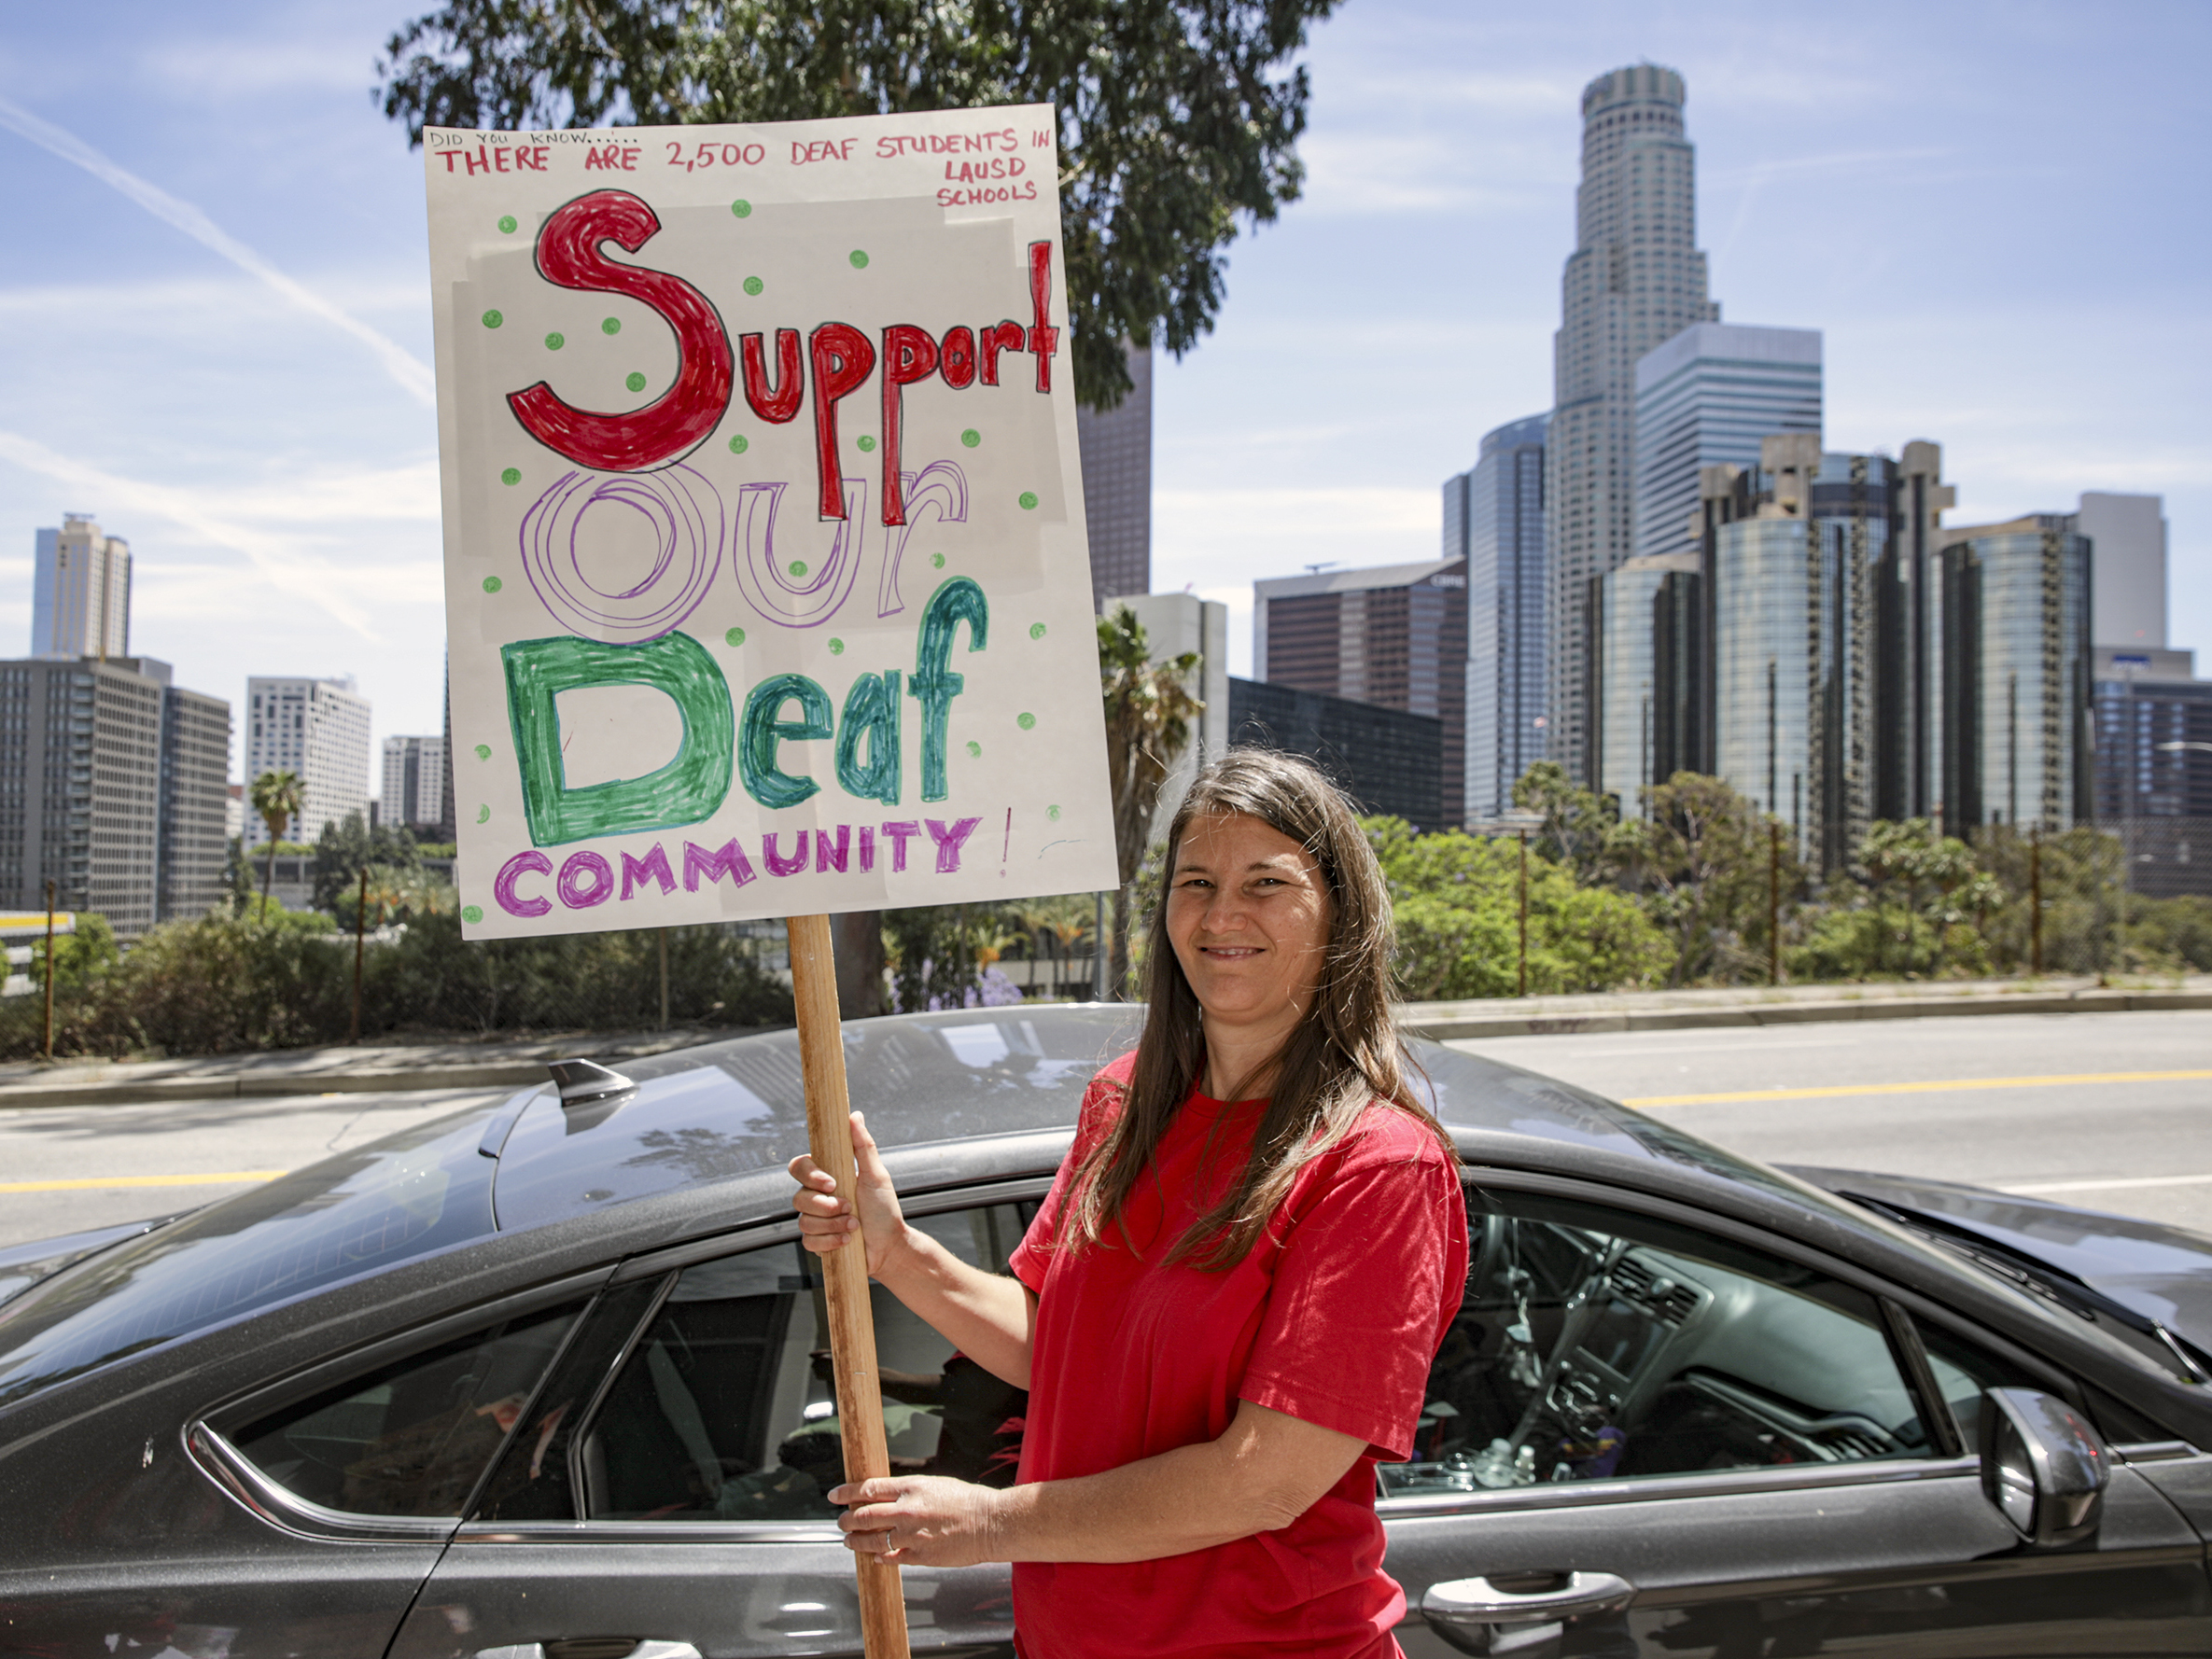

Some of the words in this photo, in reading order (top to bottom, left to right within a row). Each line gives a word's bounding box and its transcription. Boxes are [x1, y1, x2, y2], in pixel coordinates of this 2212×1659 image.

[430, 132, 463, 146] DID
[476, 132, 508, 145] YOU
[435, 145, 551, 175] THERE
[584, 145, 642, 171] ARE
[666, 142, 765, 173] 2,500
[791, 138, 859, 165] DEAF
[875, 128, 1018, 159] STUDENTS
[1032, 129, 1051, 148] IN
[936, 180, 1037, 207] SCHOOLS
[945, 157, 1026, 184] LAUSD
[506, 188, 1060, 527] Support
[500, 574, 989, 847] Deaf
[494, 817, 983, 918] COMMUNITY
